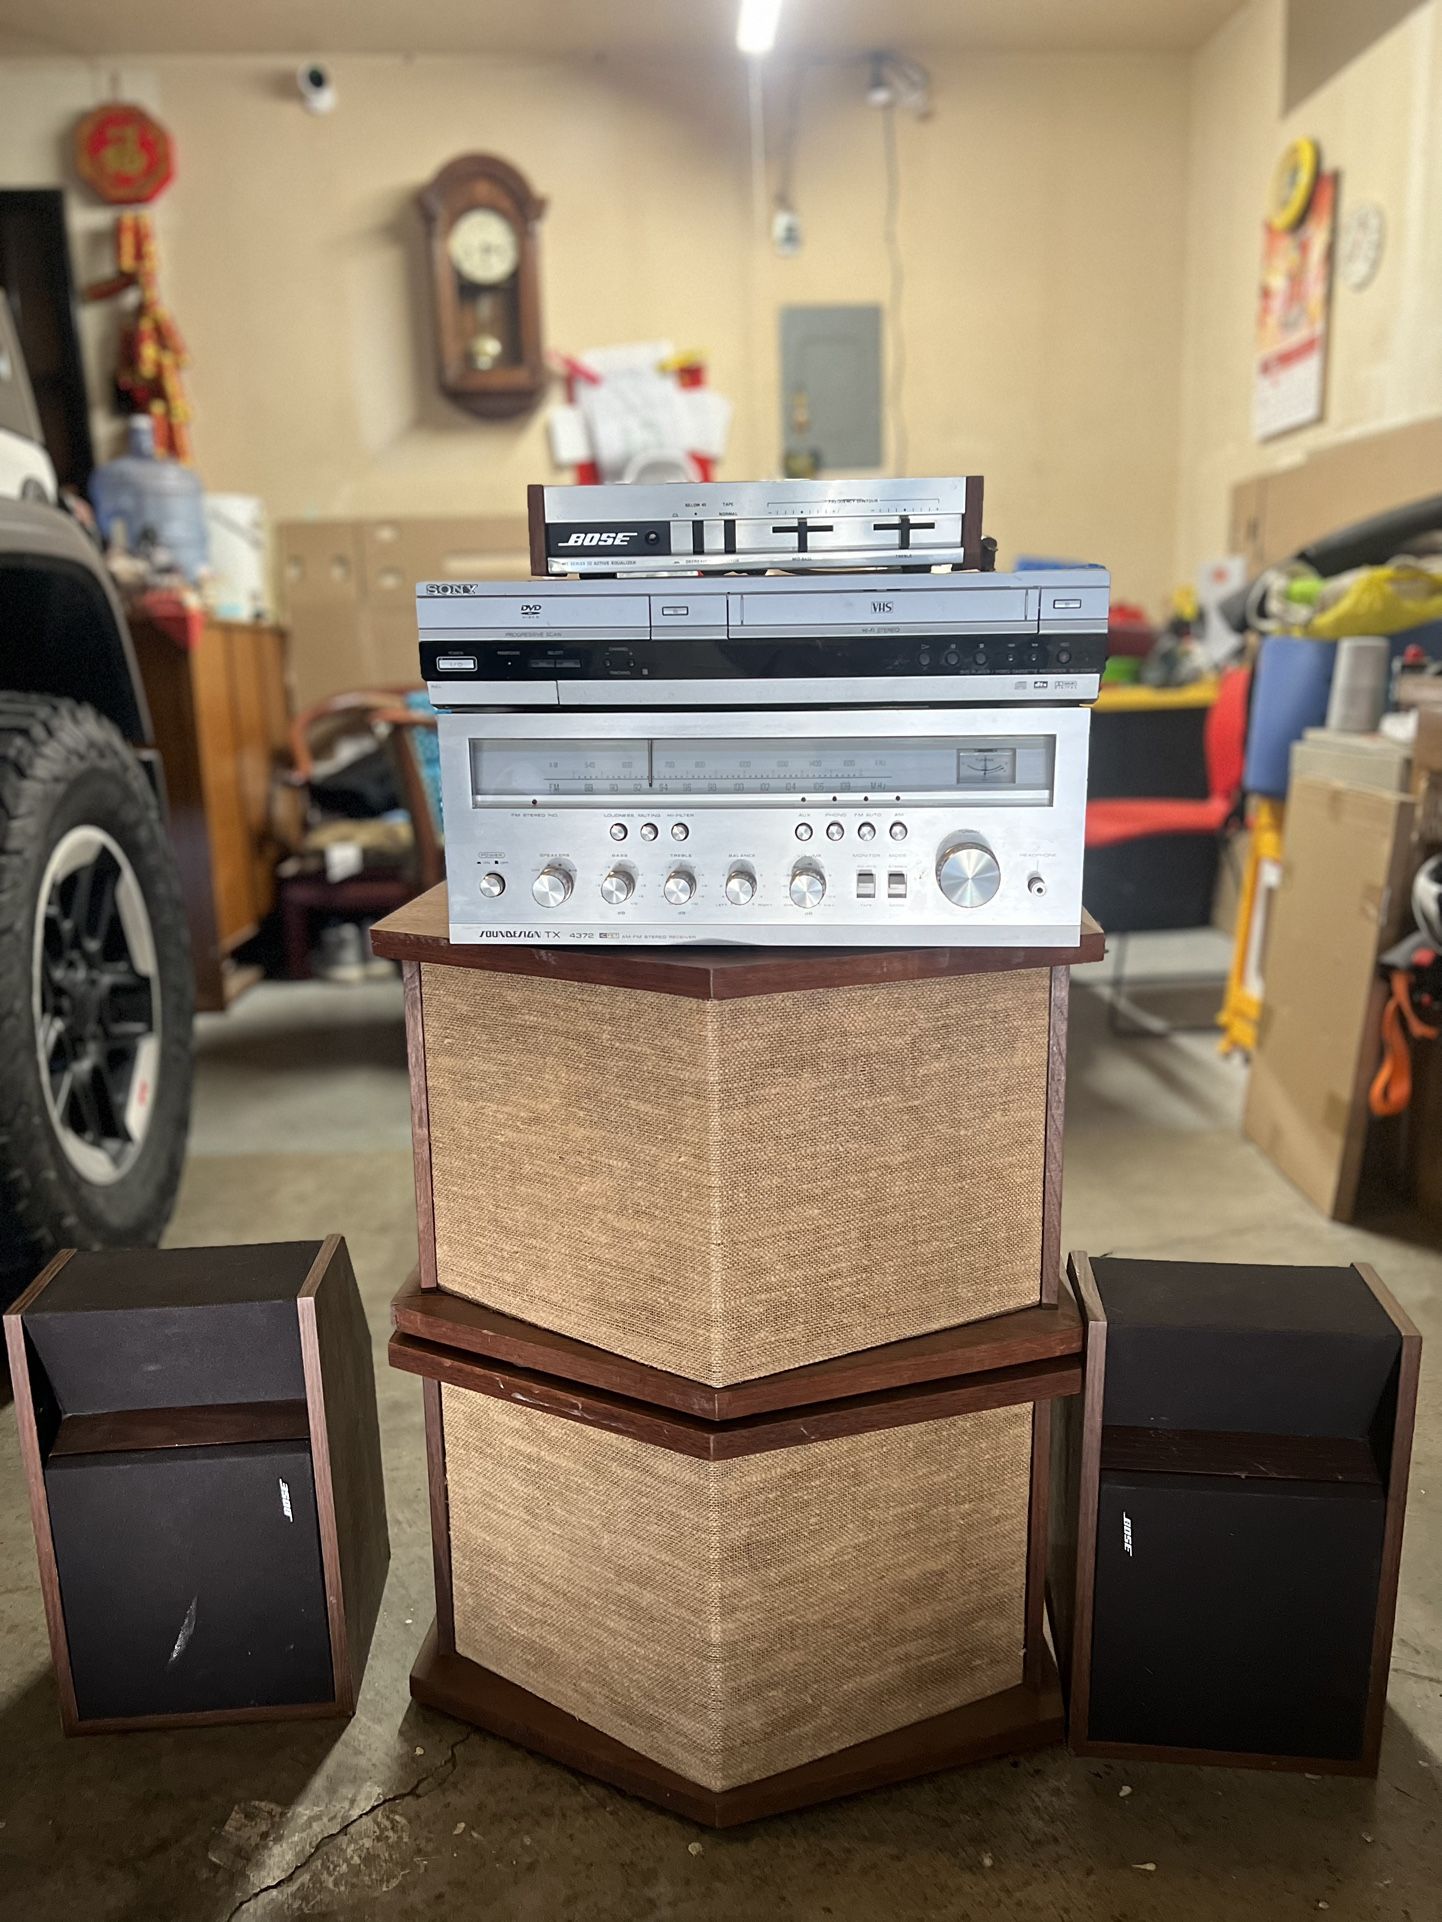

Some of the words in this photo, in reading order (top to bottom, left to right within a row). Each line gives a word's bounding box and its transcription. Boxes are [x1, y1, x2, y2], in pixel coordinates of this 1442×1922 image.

[558, 532, 638, 547] BOSE
[426, 584, 478, 595] SONY
[872, 601, 893, 613] VHS
[549, 784, 560, 792] FM
[479, 930, 542, 938] SOUNDESIGN
[544, 931, 561, 939] TX
[278, 1477, 294, 1523] BOSE
[1122, 1511, 1133, 1557] BOSE
